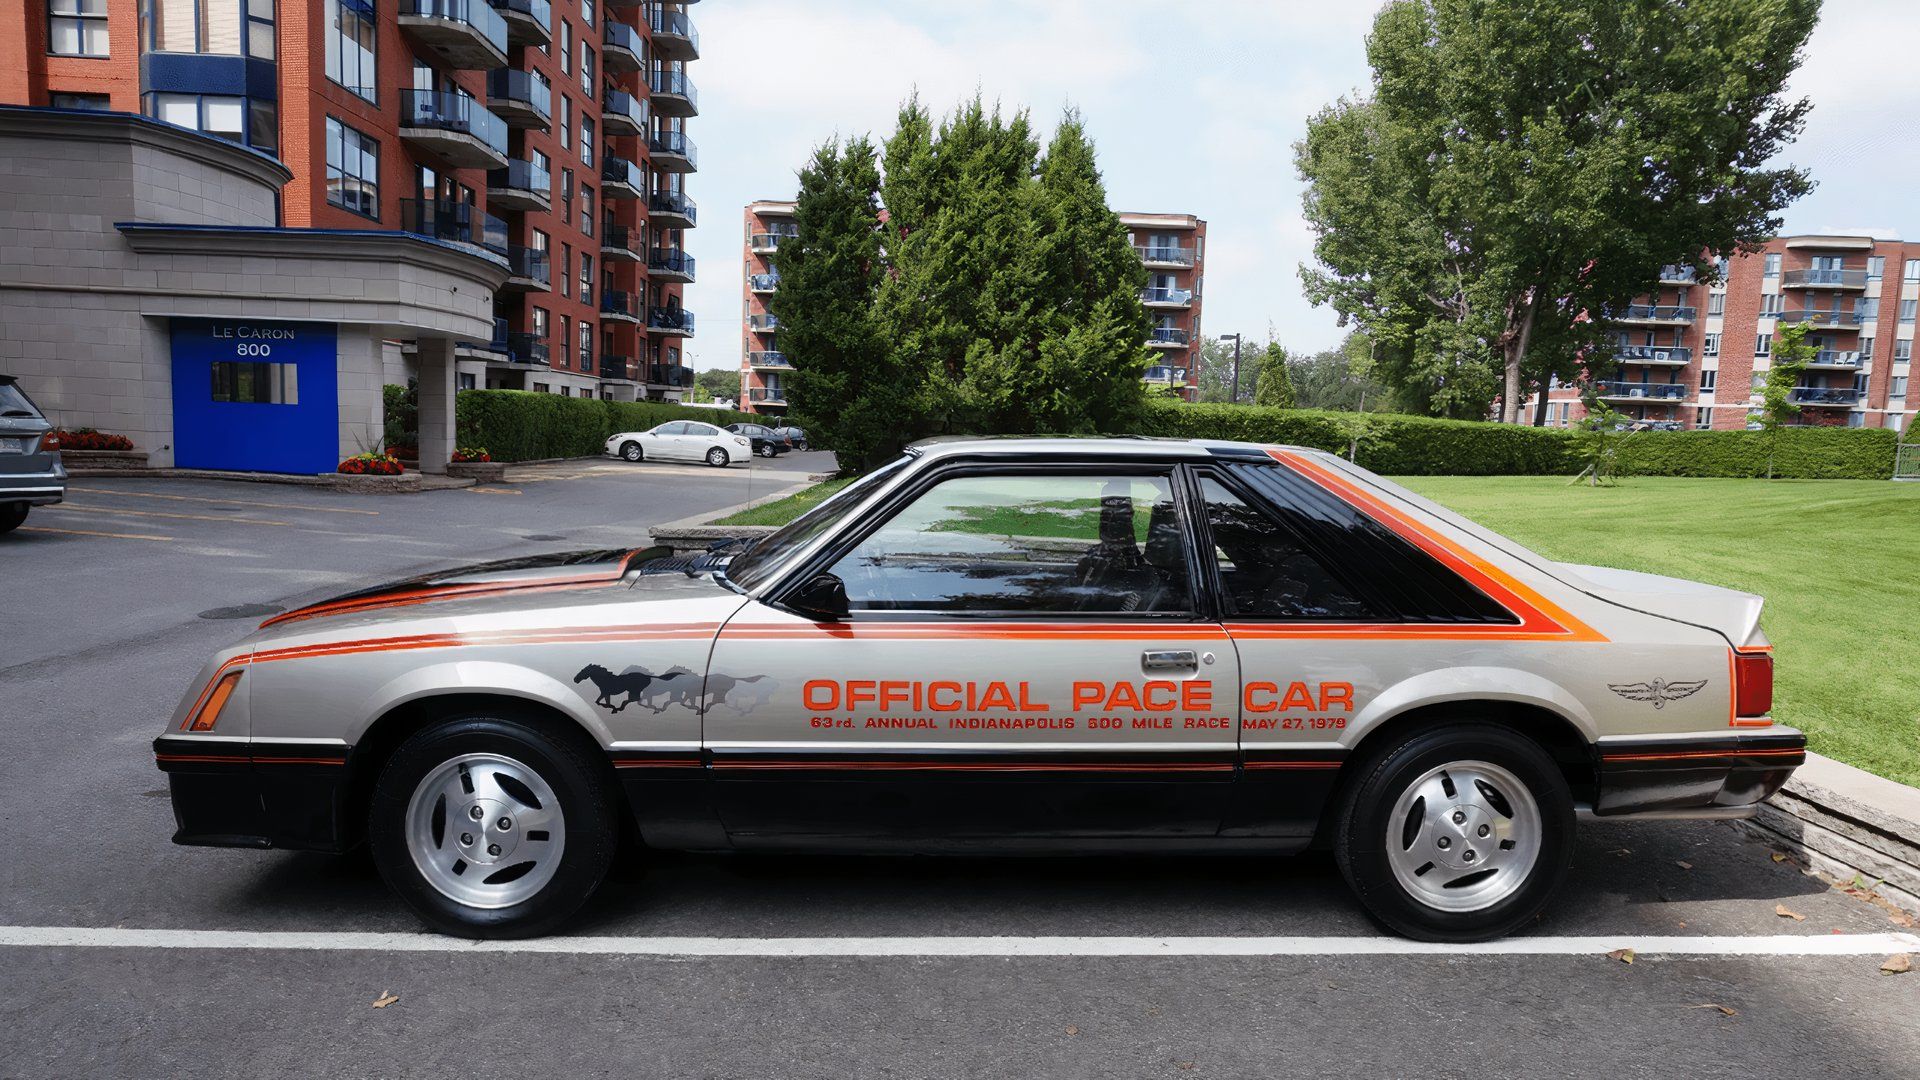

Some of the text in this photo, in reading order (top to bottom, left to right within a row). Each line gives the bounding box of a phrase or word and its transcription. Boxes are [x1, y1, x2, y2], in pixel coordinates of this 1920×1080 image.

[213, 326, 295, 340] LE CARON
[237, 343, 271, 357] 800
[803, 679, 1355, 713] OFFICIAL PACE CAR
[865, 717, 938, 730] ANNUAL
[949, 717, 1075, 730] INDIANAPOLIS
[1087, 717, 1124, 730] 500
[1131, 717, 1173, 730] MILE
[1183, 717, 1231, 730] RACE
[1242, 718, 1278, 730] MAY
